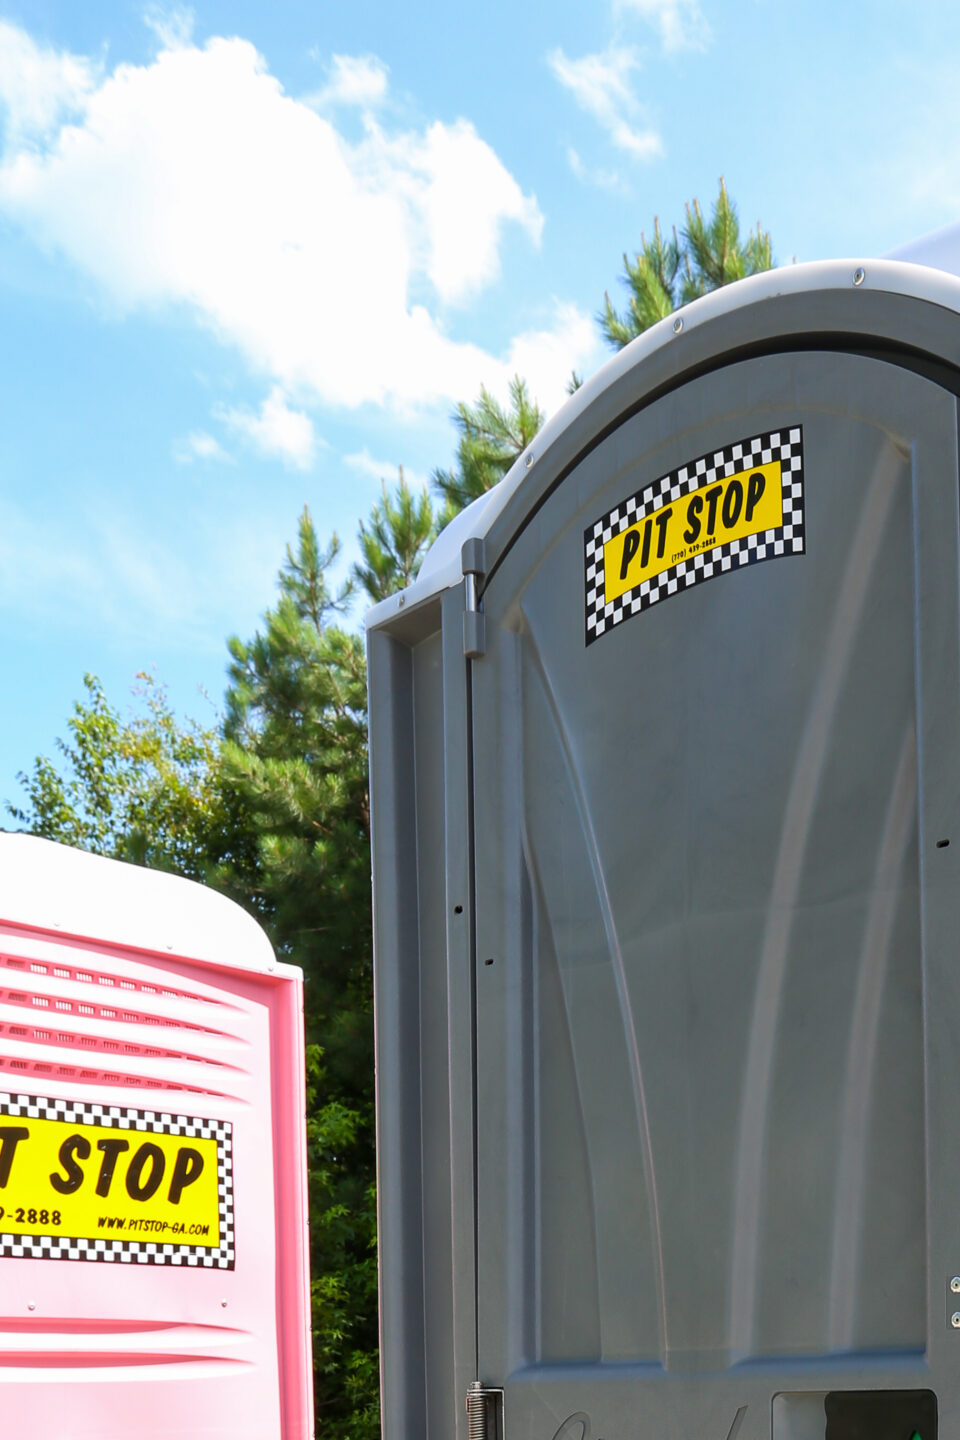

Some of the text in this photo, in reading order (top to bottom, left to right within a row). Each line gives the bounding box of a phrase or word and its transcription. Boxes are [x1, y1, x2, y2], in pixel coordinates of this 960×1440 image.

[619, 472, 766, 580] PIT STOP
[671, 548, 687, 563] (770)
[49, 1133, 205, 1205] STOP
[97, 1216, 210, 1236] WWW.PITSTOP-GA.COM
